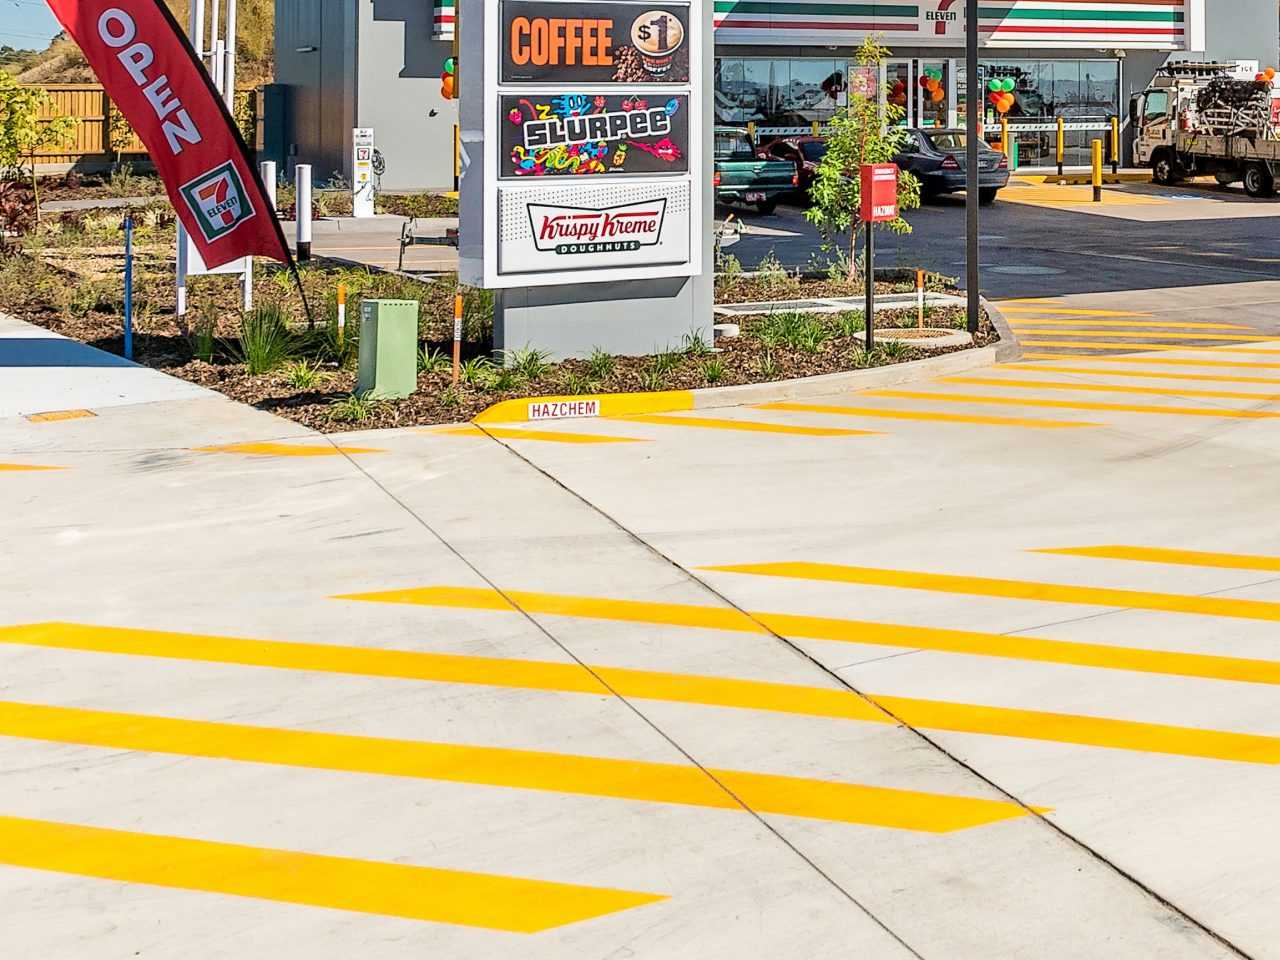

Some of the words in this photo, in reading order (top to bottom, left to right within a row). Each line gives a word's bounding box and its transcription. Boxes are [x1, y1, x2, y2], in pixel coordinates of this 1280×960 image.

[510, 15, 614, 66] COFFEE
[98, 7, 203, 156] OPEN
[540, 214, 603, 241] Krispy
[601, 211, 659, 237] Kreme
[561, 242, 636, 253] DOUGHNUTS
[532, 401, 596, 418] HAZCHEM
